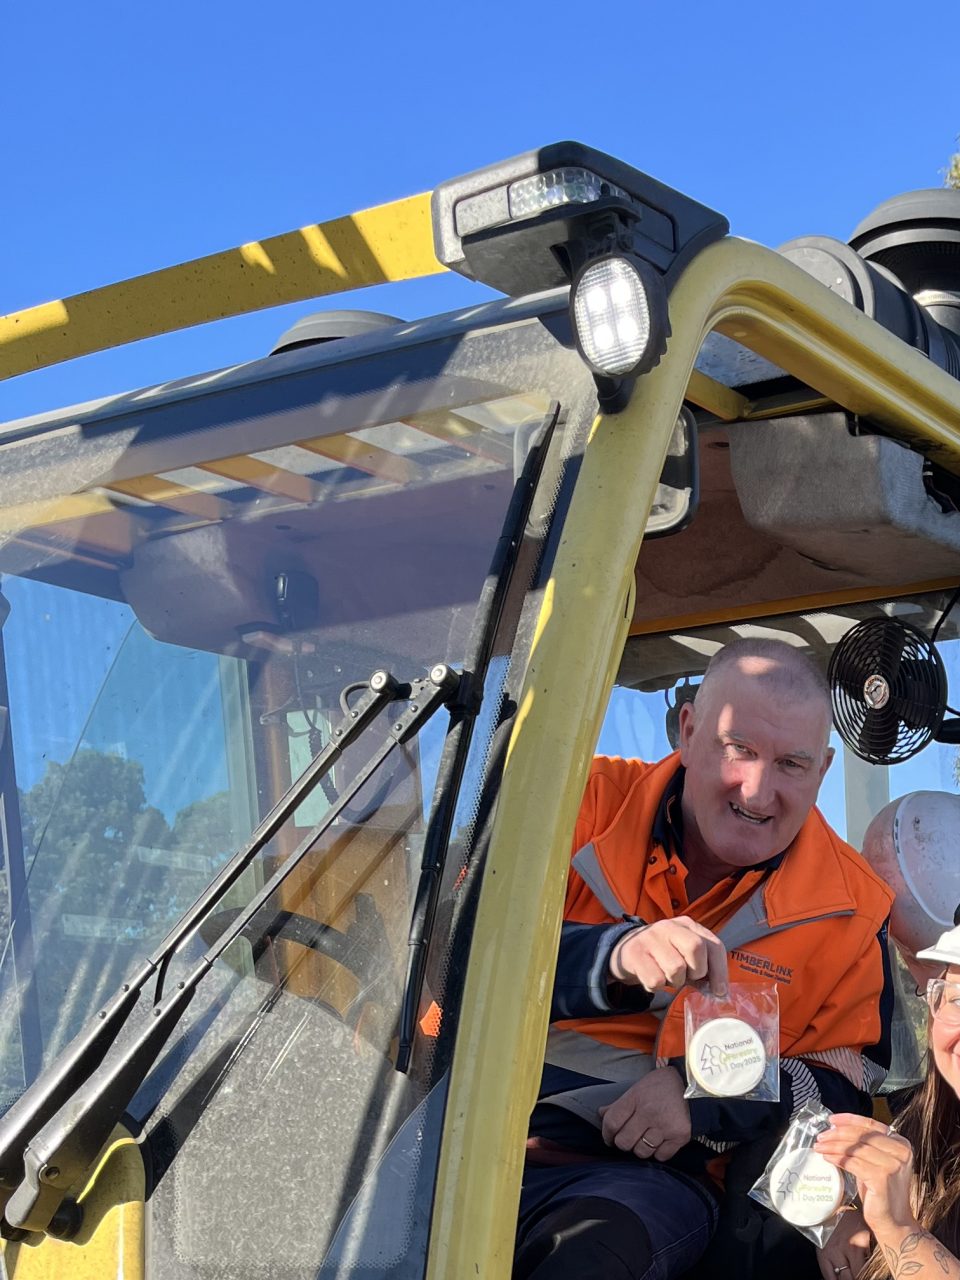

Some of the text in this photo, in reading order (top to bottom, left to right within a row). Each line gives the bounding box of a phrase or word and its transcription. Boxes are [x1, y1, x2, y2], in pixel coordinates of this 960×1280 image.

[731, 951, 794, 977] TIMBERLINK
[724, 1037, 753, 1051] National
[730, 1055, 761, 1070] Day 2025
[804, 1174, 832, 1182] National
